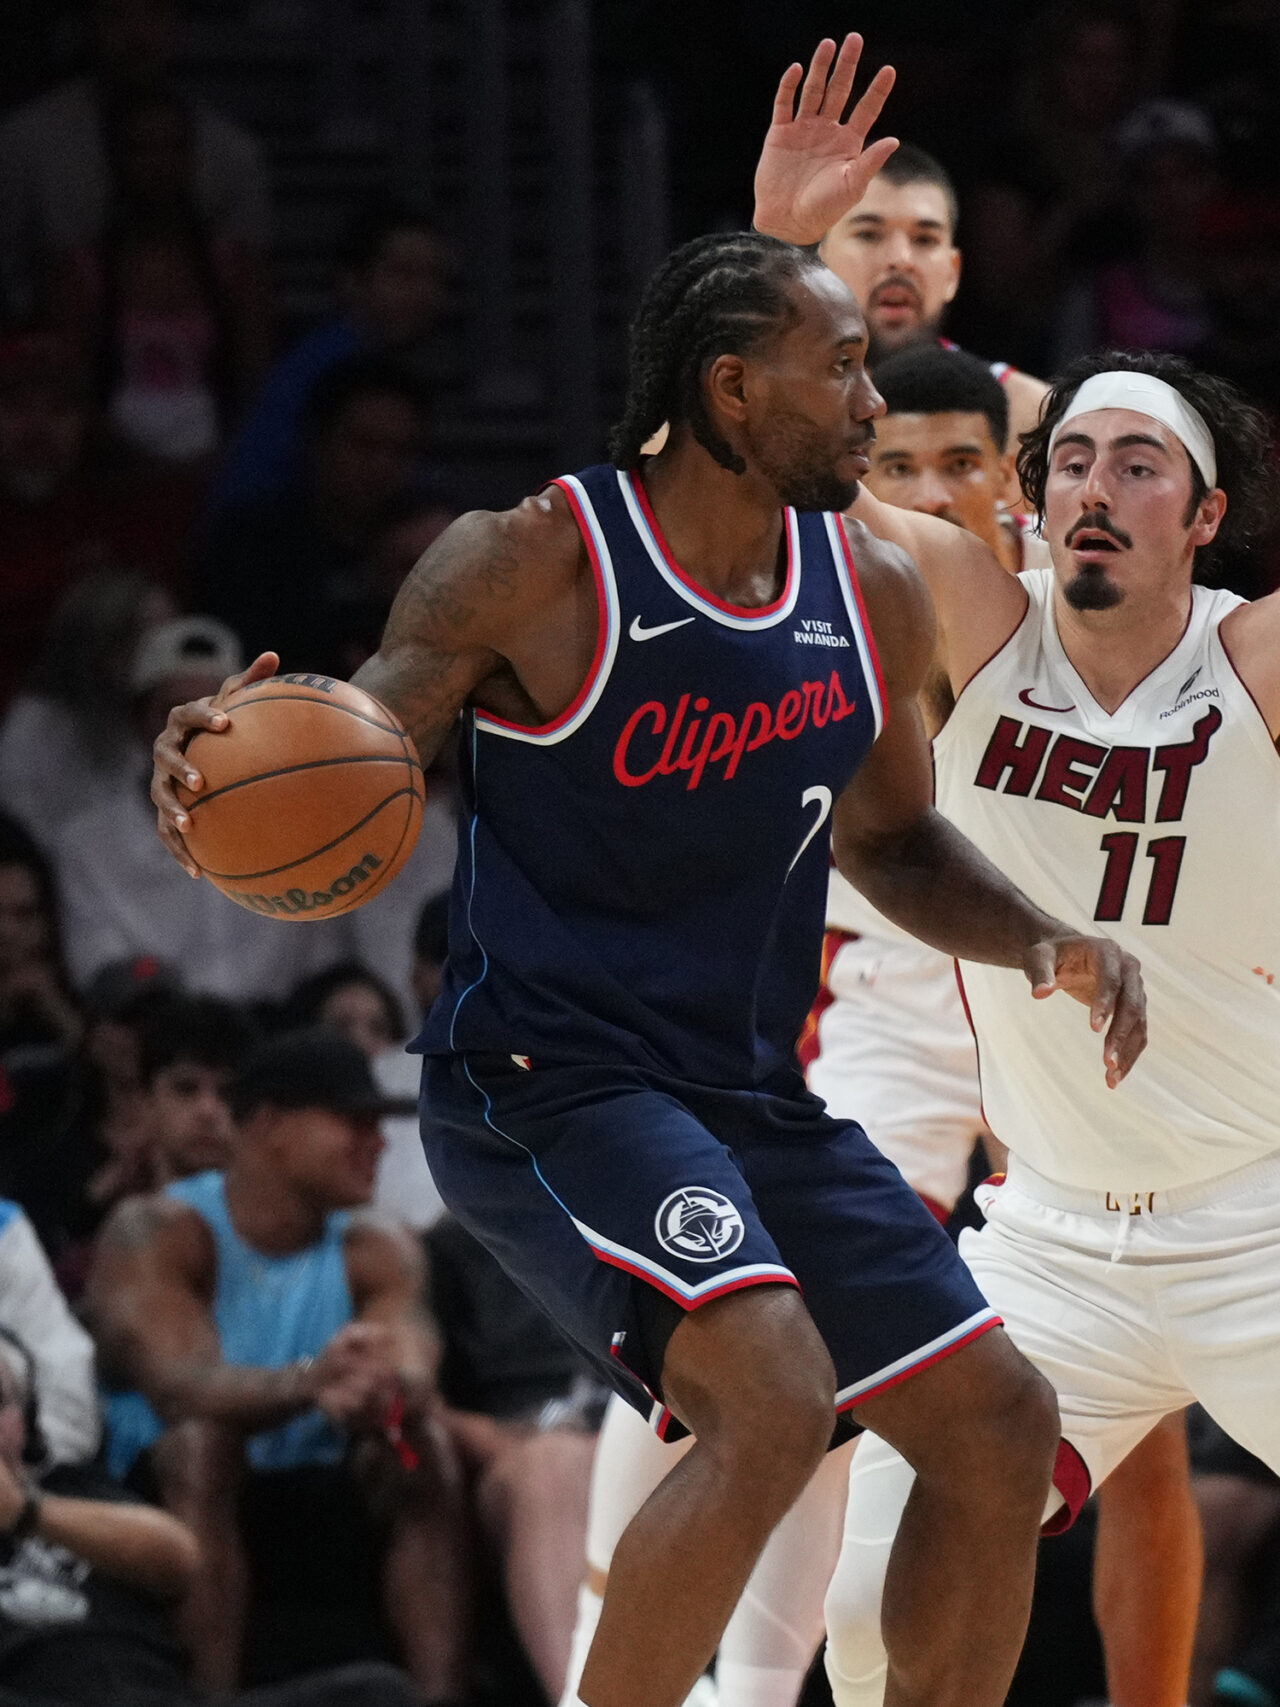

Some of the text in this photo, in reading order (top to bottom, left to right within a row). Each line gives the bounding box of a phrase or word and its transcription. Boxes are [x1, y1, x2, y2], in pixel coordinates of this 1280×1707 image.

[794, 631, 850, 648] RWANDA
[801, 619, 832, 635] VISIT
[613, 670, 856, 791] Clippers
[1159, 687, 1220, 721] Robinhood
[973, 704, 1223, 824] HEAT
[1093, 831, 1187, 926] 11
